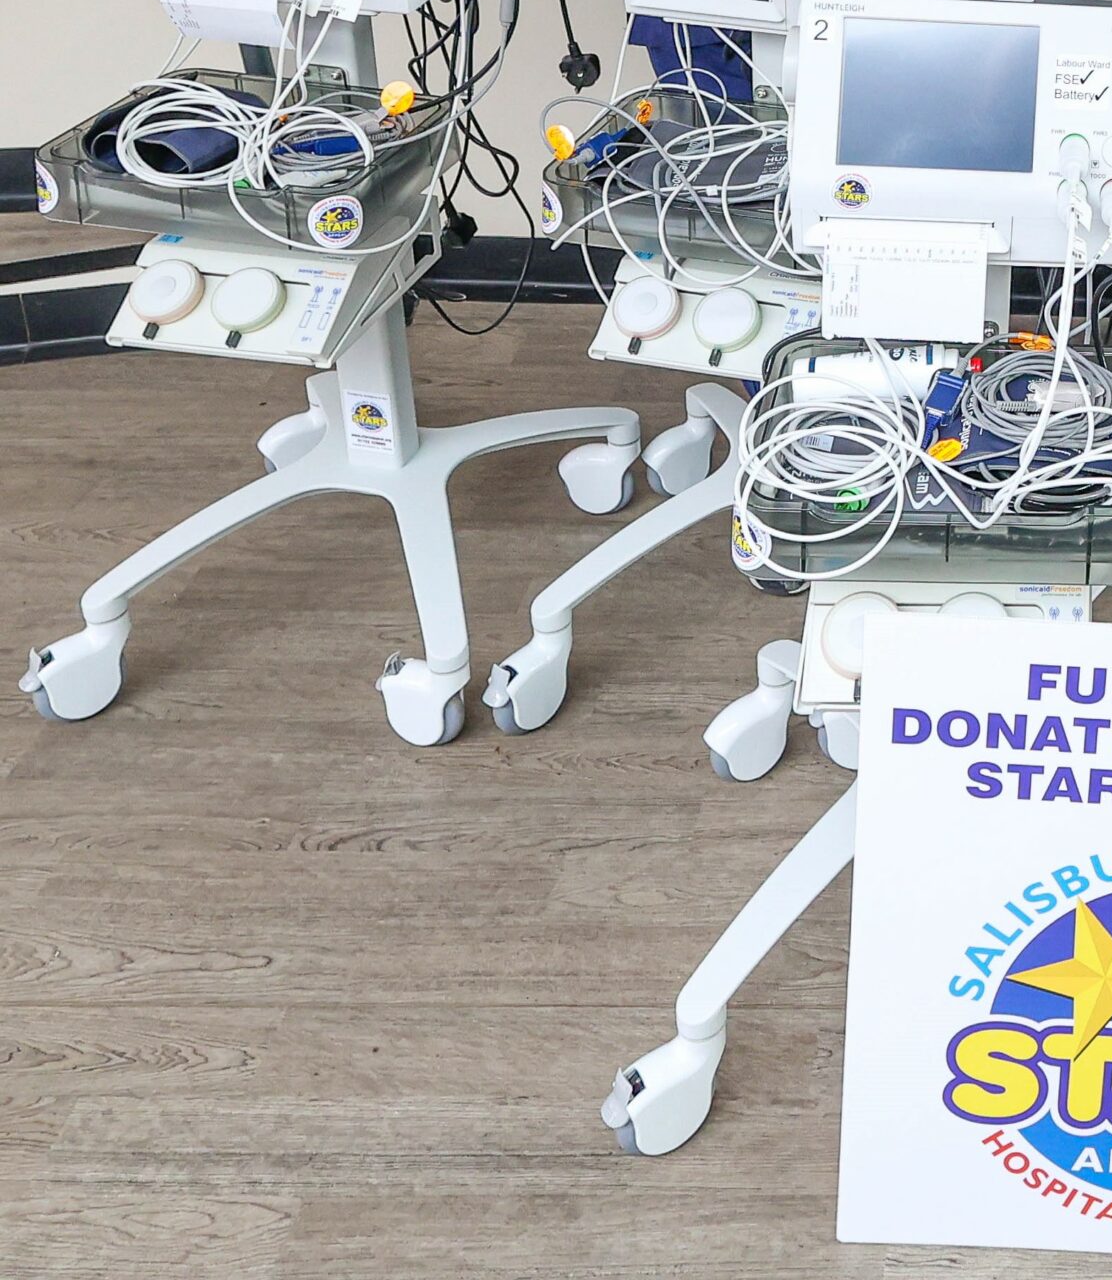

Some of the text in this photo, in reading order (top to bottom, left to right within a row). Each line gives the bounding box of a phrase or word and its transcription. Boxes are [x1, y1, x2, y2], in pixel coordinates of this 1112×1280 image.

[813, 2, 865, 12] HUNTLEIGH
[813, 19, 829, 41] 2
[1055, 59, 1111, 69] Labour Ward
[1054, 74, 1080, 85] FSE
[1054, 89, 1095, 103] Battery
[834, 190, 870, 203] STARS
[315, 218, 358, 232] STARS
